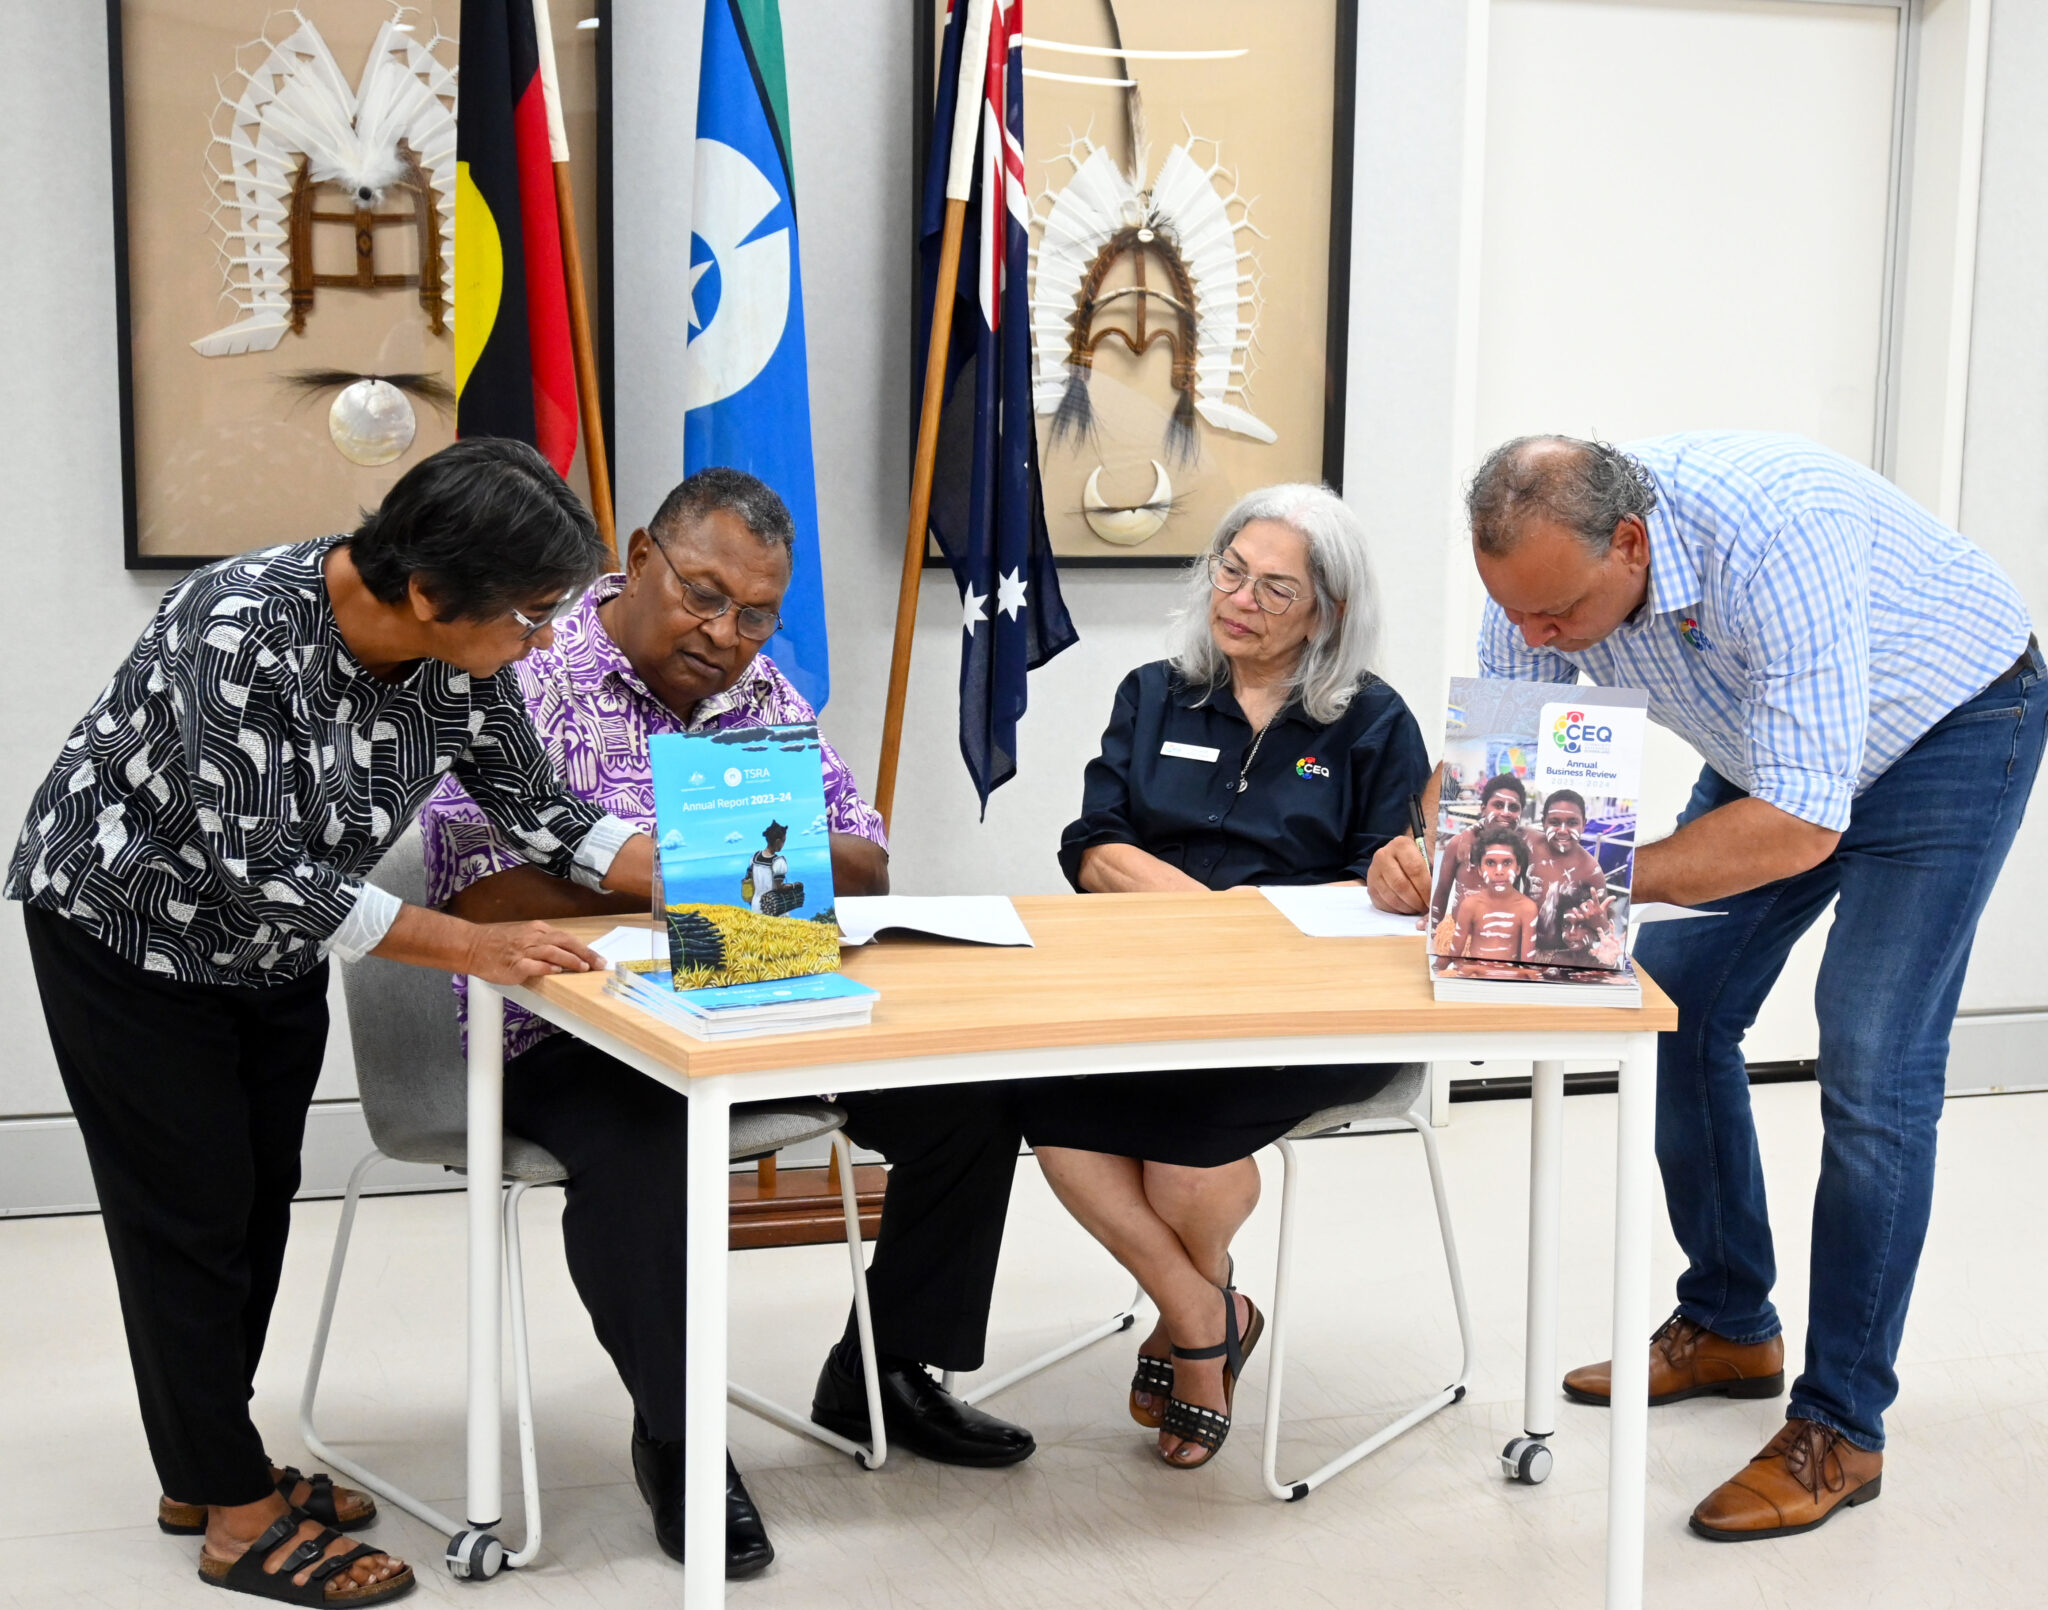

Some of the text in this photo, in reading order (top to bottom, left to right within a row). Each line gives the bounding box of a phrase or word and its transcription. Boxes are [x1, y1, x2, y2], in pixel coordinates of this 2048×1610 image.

[1566, 724, 1612, 742] CEQ
[1304, 763, 1330, 778] CEQ
[1567, 760, 1598, 769] Annual
[744, 768, 770, 779] TSRA
[1546, 766, 1617, 779] Business Review
[1551, 778, 1574, 786] 2023
[1586, 780, 1610, 788] 2024
[682, 799, 715, 812] Annual
[717, 797, 749, 809] Report
